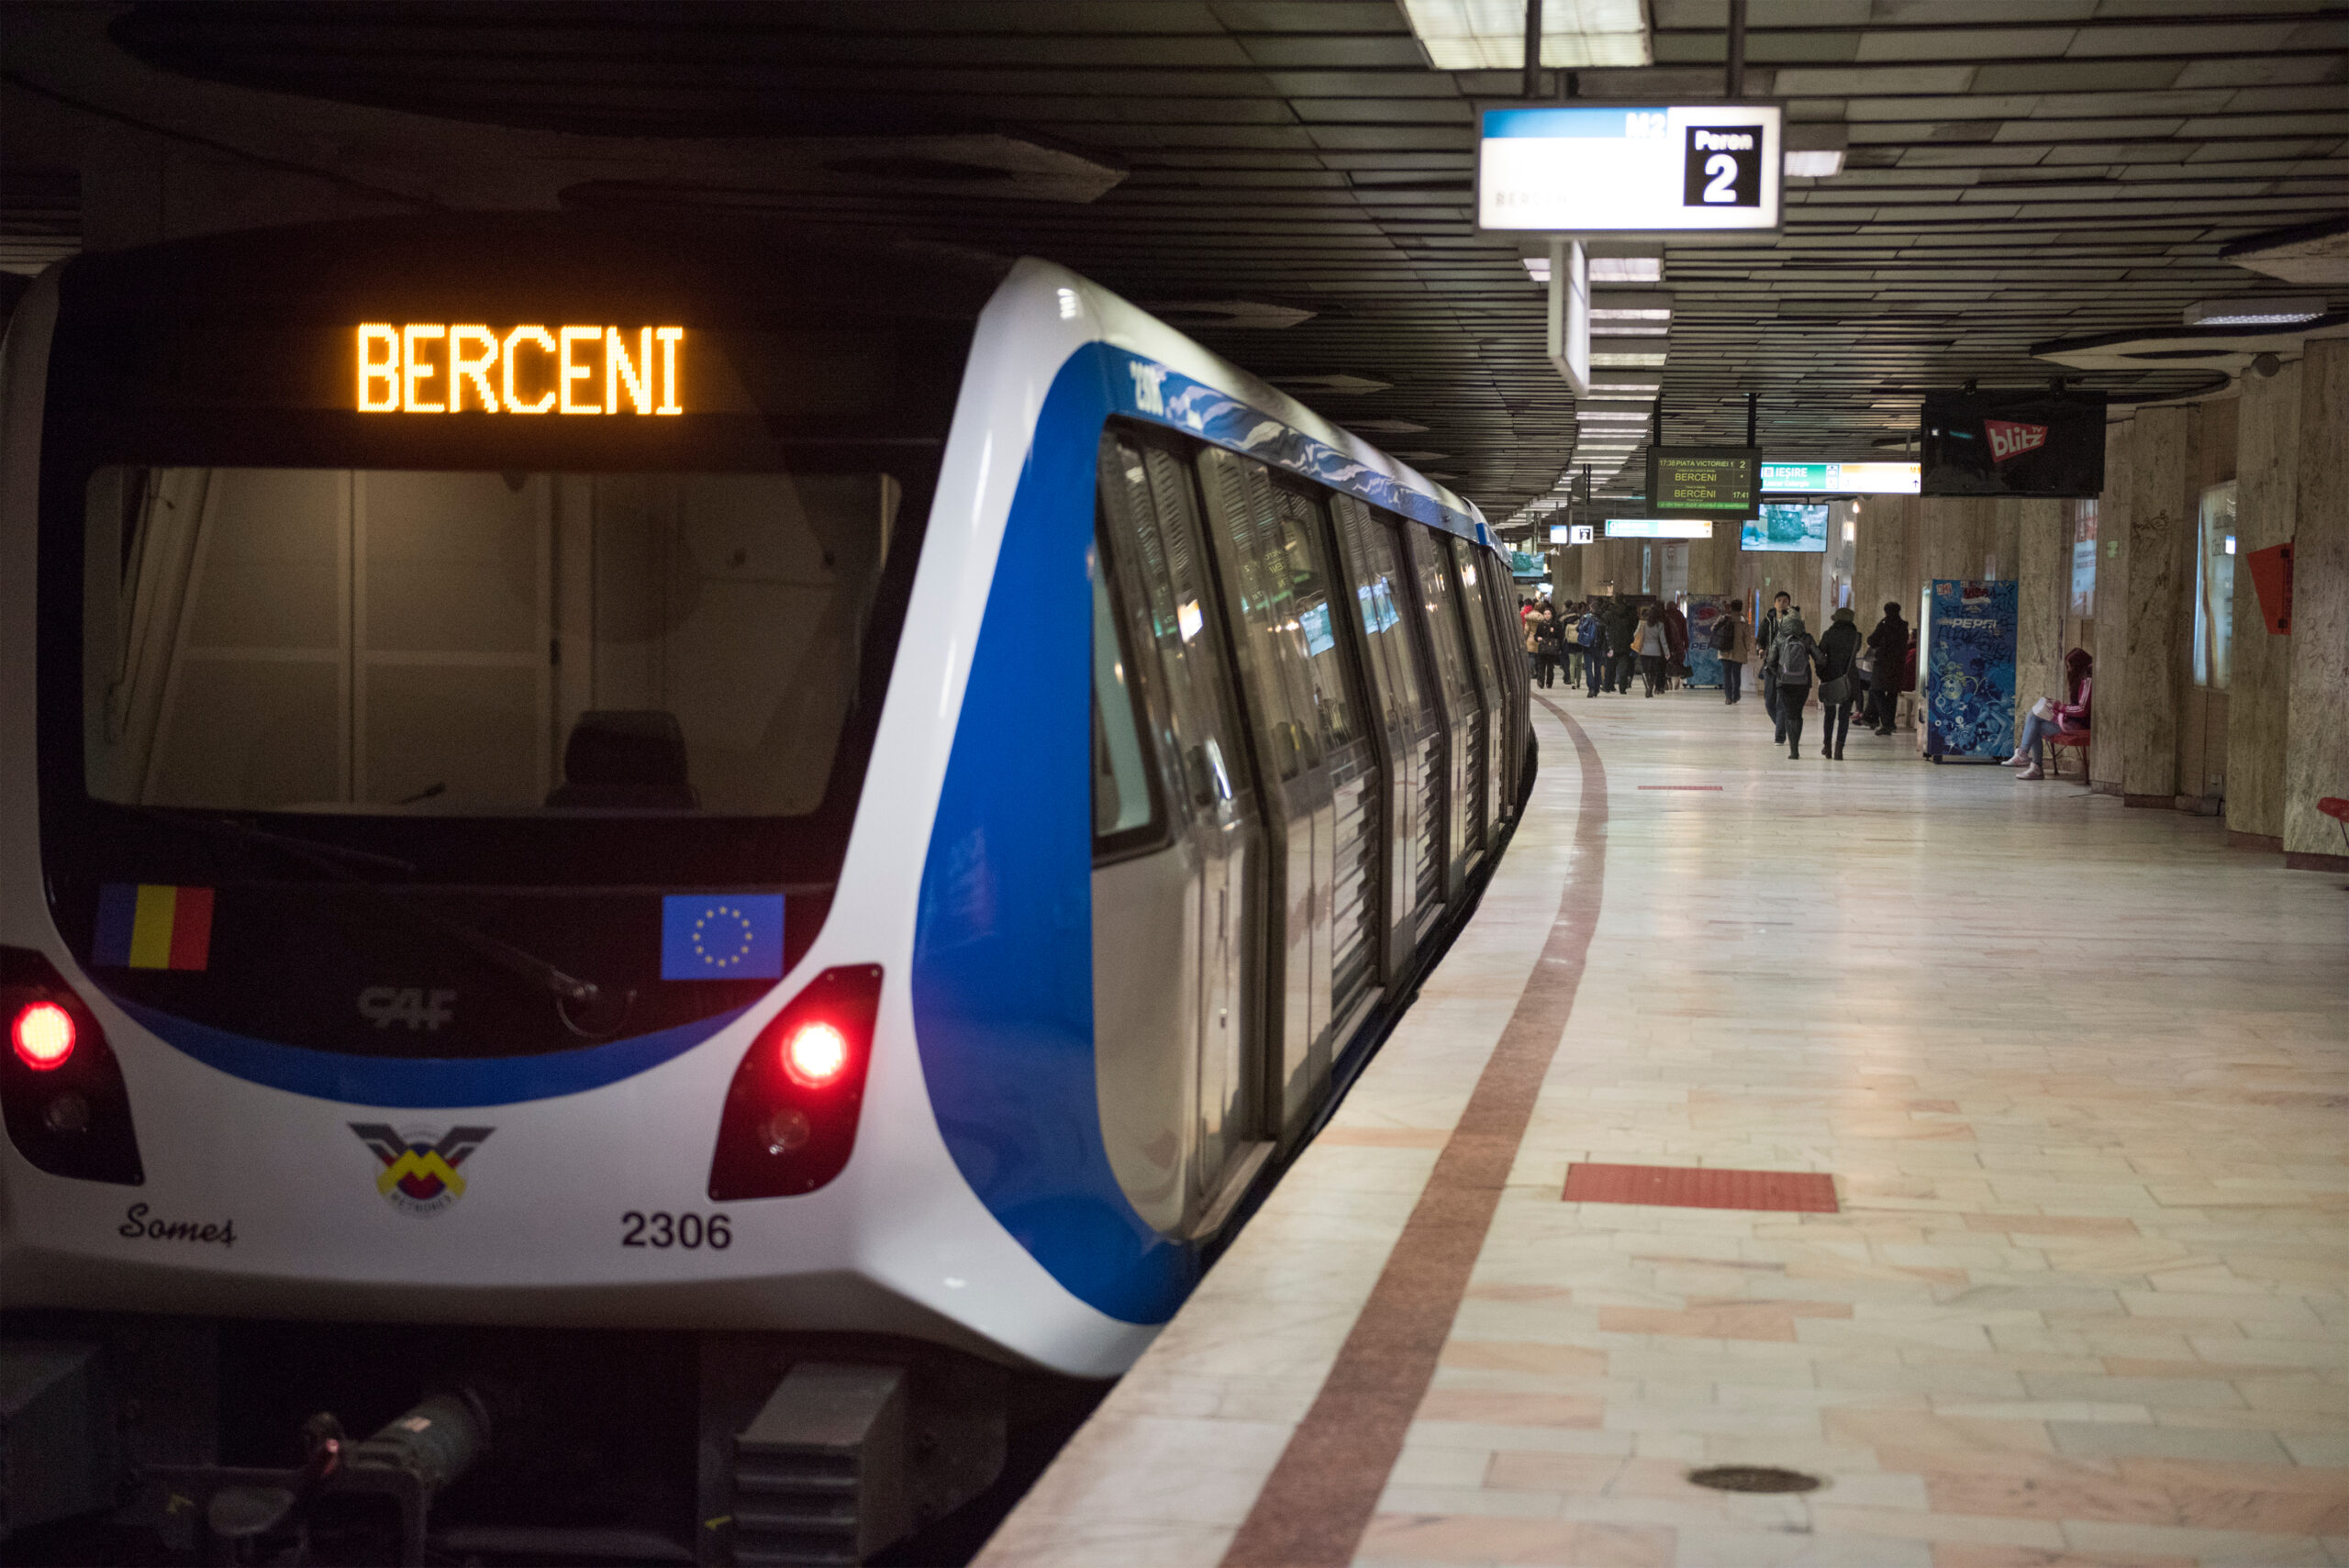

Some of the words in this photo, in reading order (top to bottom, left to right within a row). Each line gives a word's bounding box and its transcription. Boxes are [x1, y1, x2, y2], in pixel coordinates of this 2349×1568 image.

[1625, 113, 1666, 139] M2
[1695, 130, 1753, 150] Peron
[1703, 153, 1738, 202] 2
[358, 322, 684, 416] BERCENI
[1989, 427, 2043, 457] blitz
[1740, 461, 1746, 469] 2
[1675, 473, 1717, 482] BERCENI
[1674, 489, 1716, 498] BERCENI
[1732, 491, 1749, 499] 17:41
[1952, 618, 1997, 628] PEPSI
[357, 985, 458, 1028] CAF
[622, 1210, 731, 1249] 2306
